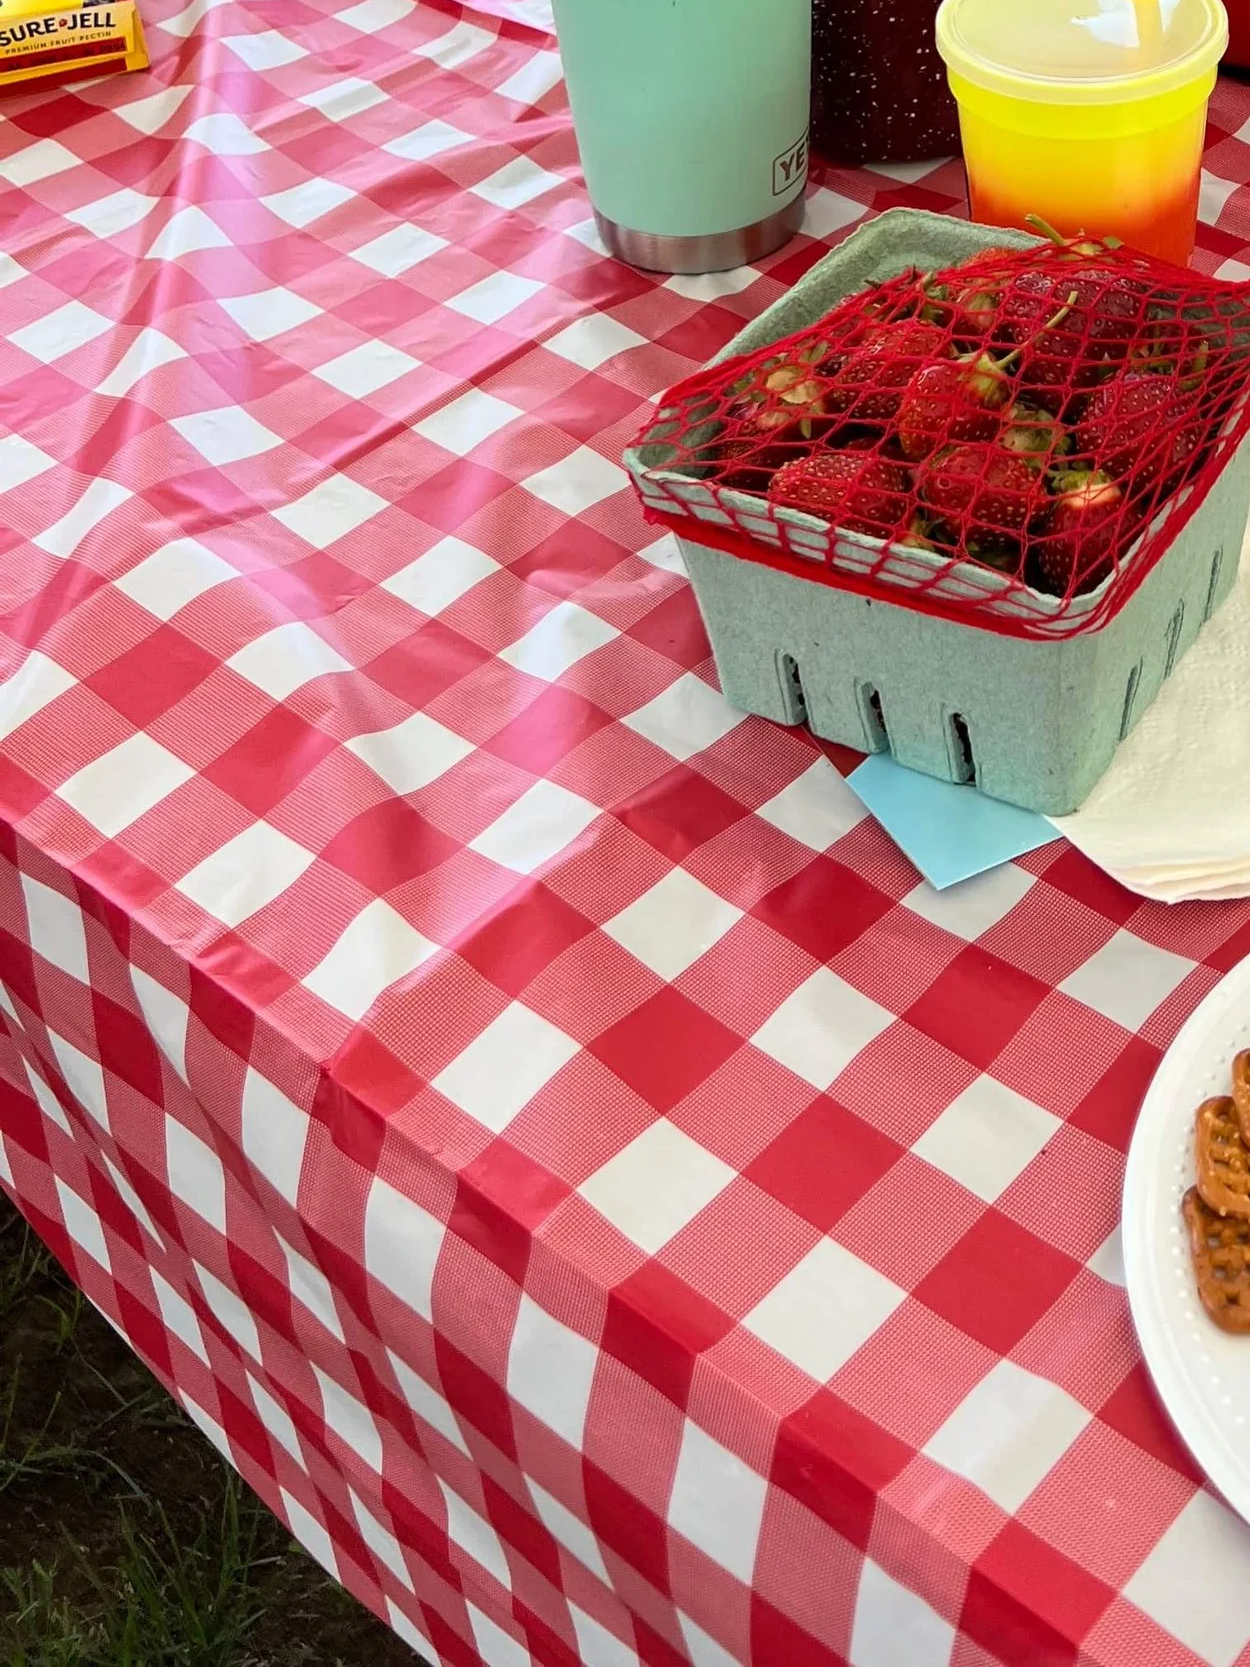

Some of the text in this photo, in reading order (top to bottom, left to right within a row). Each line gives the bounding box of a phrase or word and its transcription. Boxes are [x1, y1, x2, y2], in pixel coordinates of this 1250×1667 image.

[0, 12, 116, 47] SURE JELL
[5, 31, 112, 54] PREMIUM FRUIT PECTIN
